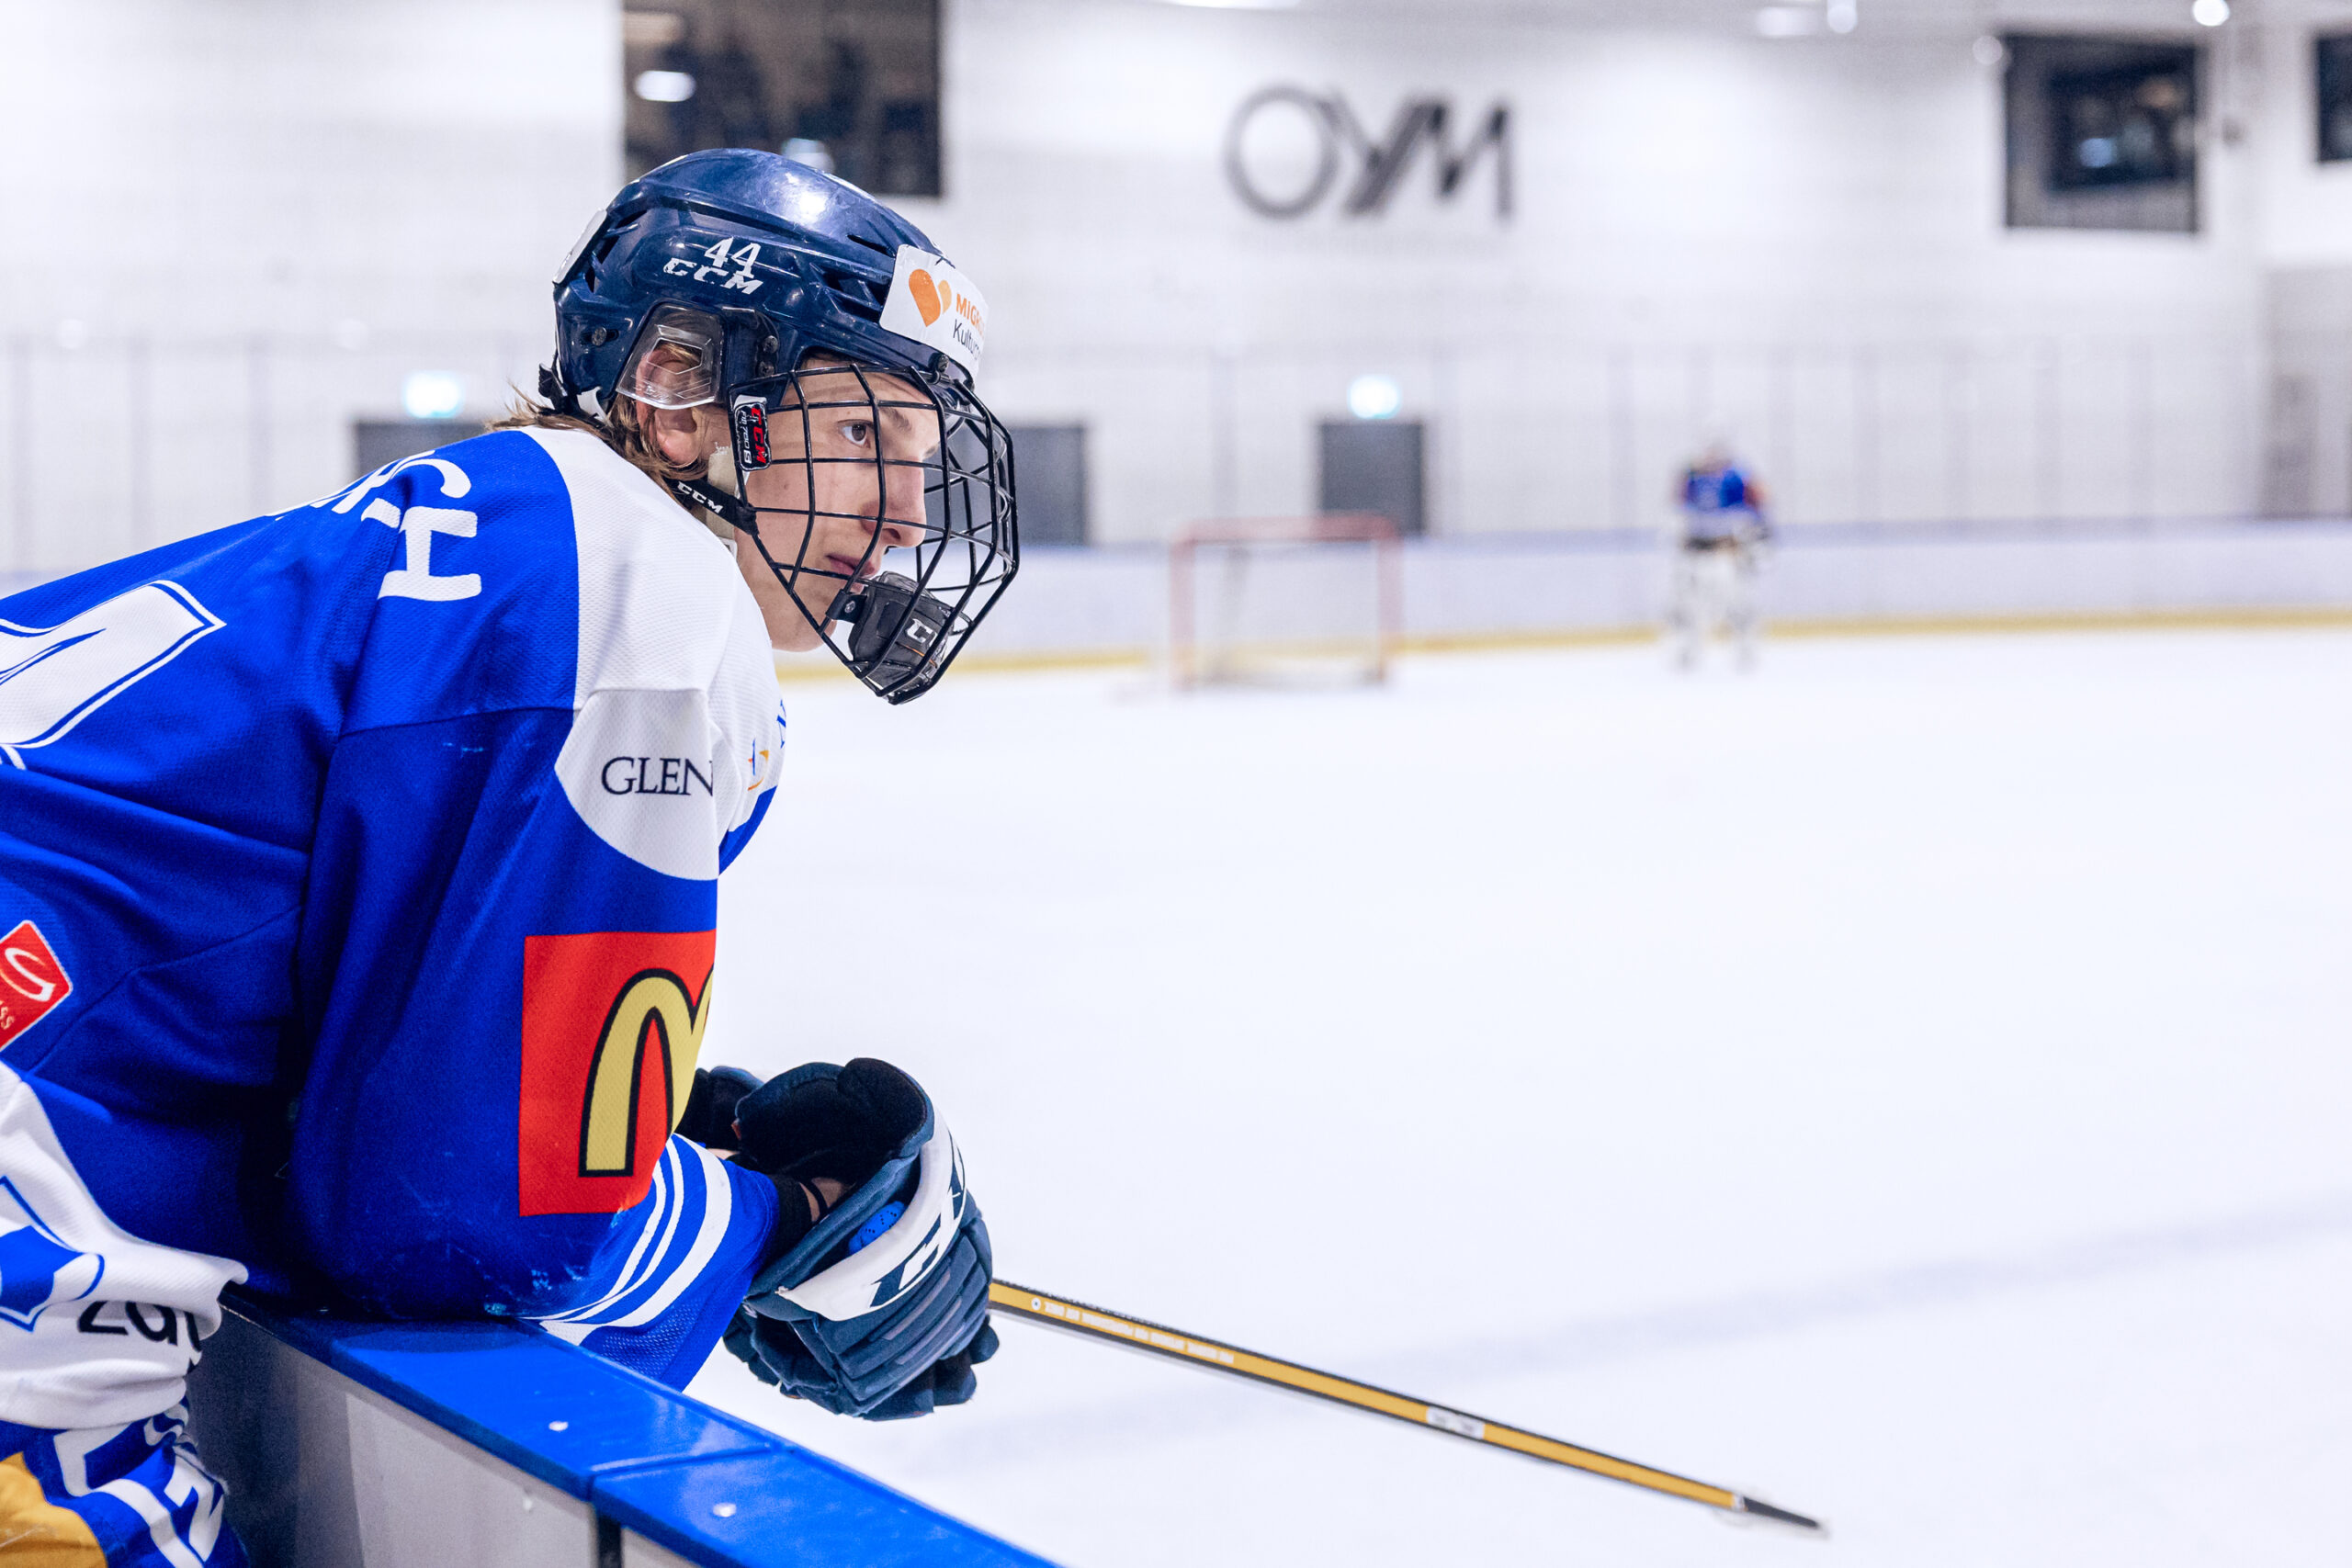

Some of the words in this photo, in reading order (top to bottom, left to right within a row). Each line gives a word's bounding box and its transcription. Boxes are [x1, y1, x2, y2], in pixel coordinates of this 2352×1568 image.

[1226, 85, 1516, 223] OYM
[662, 257, 763, 295] CCM
[704, 236, 761, 278] 44
[751, 407, 766, 464] CCM
[677, 480, 724, 514] CCM
